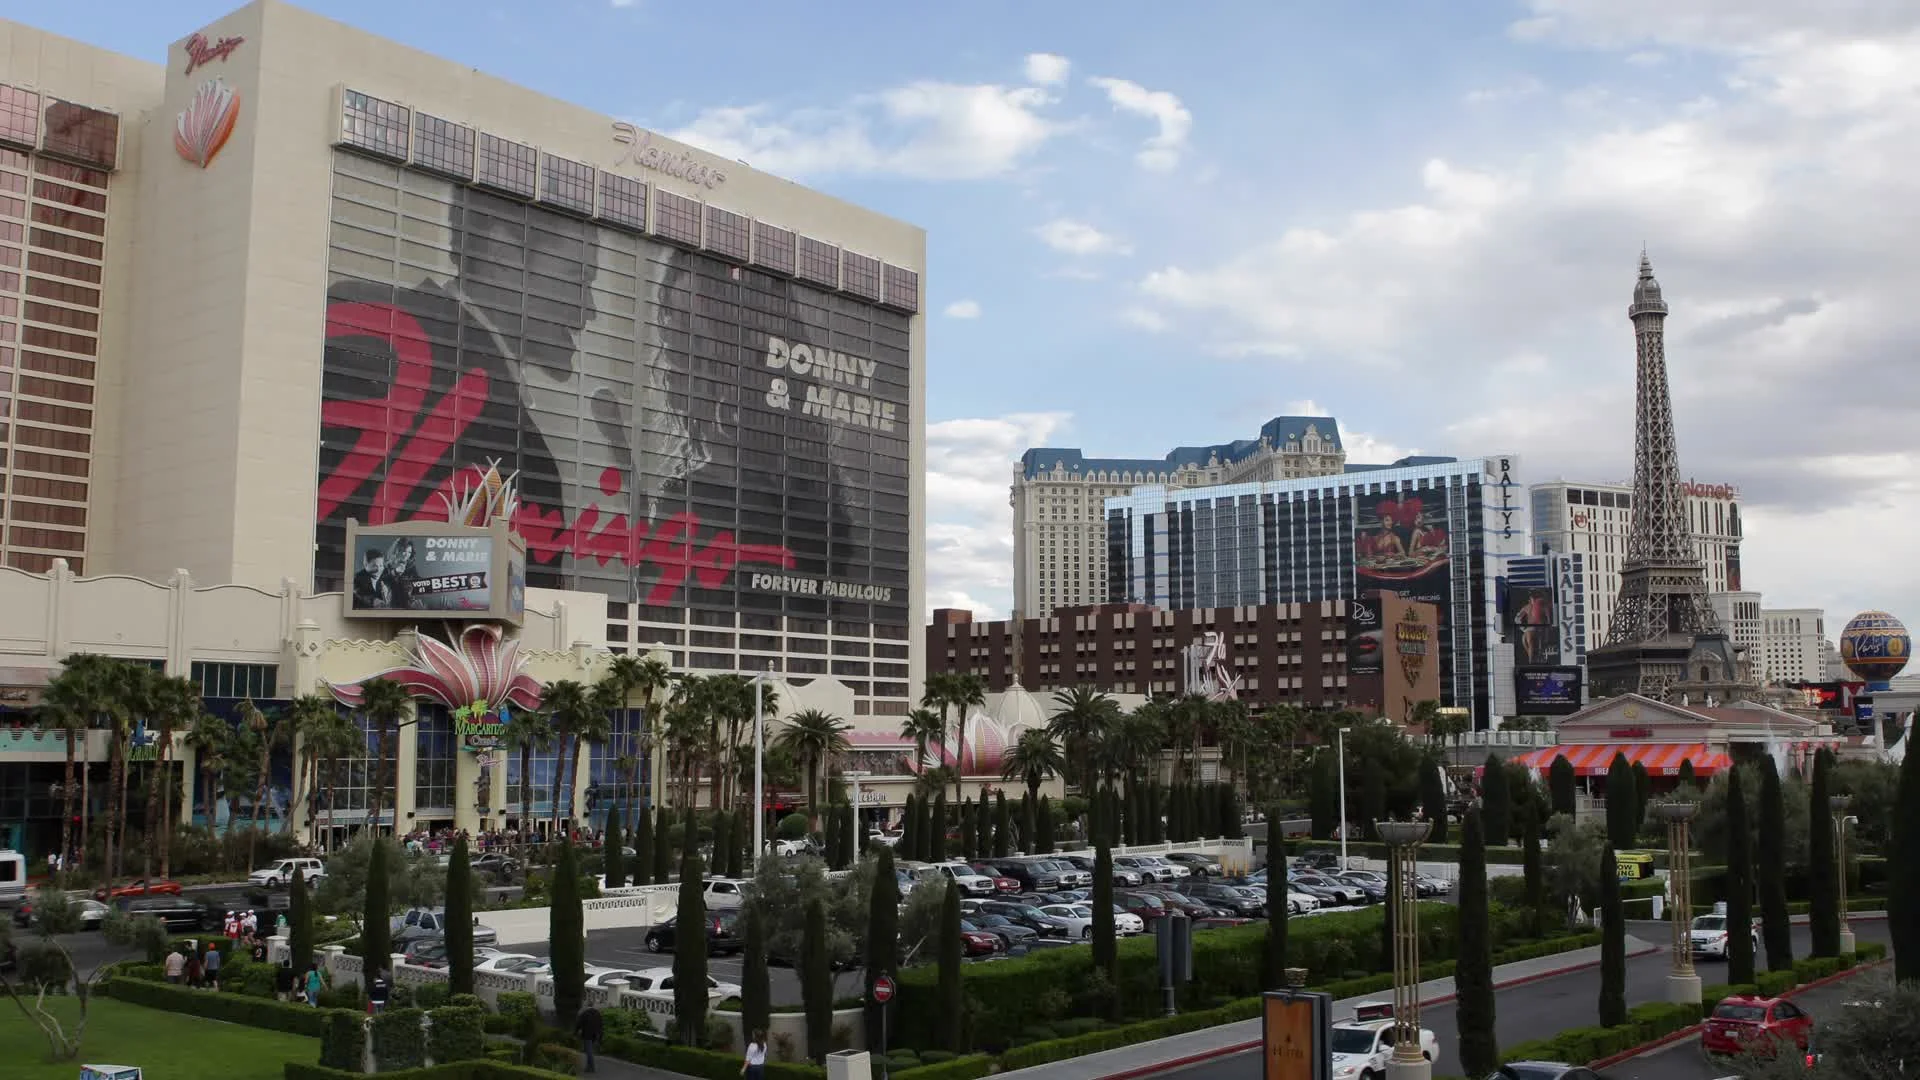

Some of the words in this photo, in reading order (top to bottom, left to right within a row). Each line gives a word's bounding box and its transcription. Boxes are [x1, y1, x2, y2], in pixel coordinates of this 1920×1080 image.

[766, 336, 878, 389] DONNY
[766, 378, 790, 411] &
[802, 385, 896, 433] MARIE
[426, 538, 480, 549] DONNY
[426, 551, 437, 562] &
[443, 551, 490, 562] MARIE
[412, 580, 431, 588] VOTED
[432, 575, 469, 590] BEST
[752, 573, 818, 595] FOREVER
[822, 580, 891, 602] FABULOUS
[1855, 633, 1881, 662] Paris
[454, 718, 509, 736] MARGARITA
